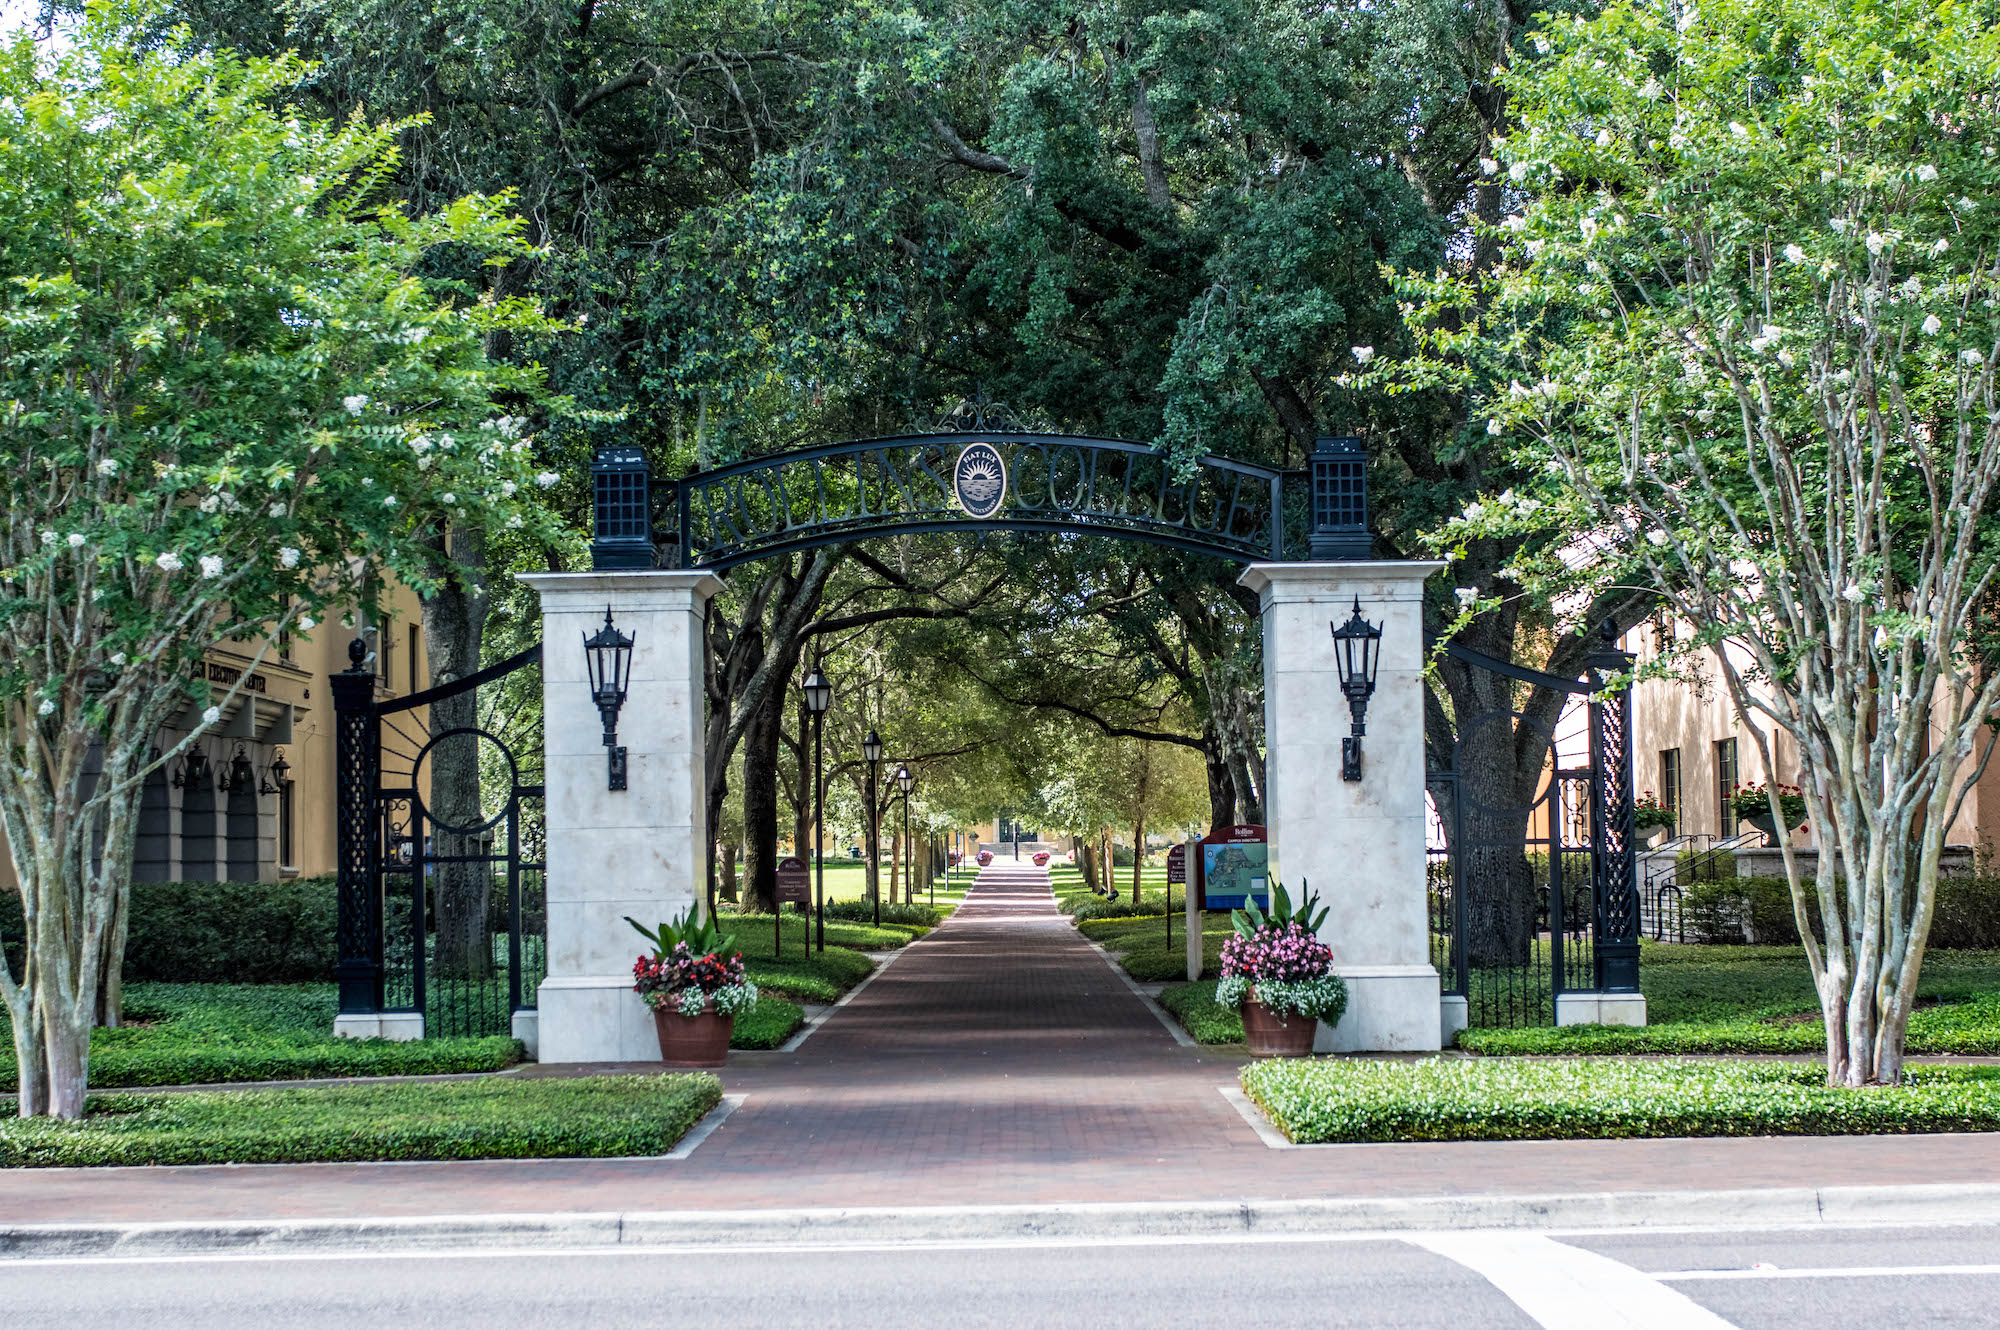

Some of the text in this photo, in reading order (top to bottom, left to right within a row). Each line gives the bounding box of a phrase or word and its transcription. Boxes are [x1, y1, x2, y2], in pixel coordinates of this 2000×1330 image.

[963, 451, 998, 464] FIAT LUX
[700, 443, 1266, 549] ROLLINS COLLEGE
